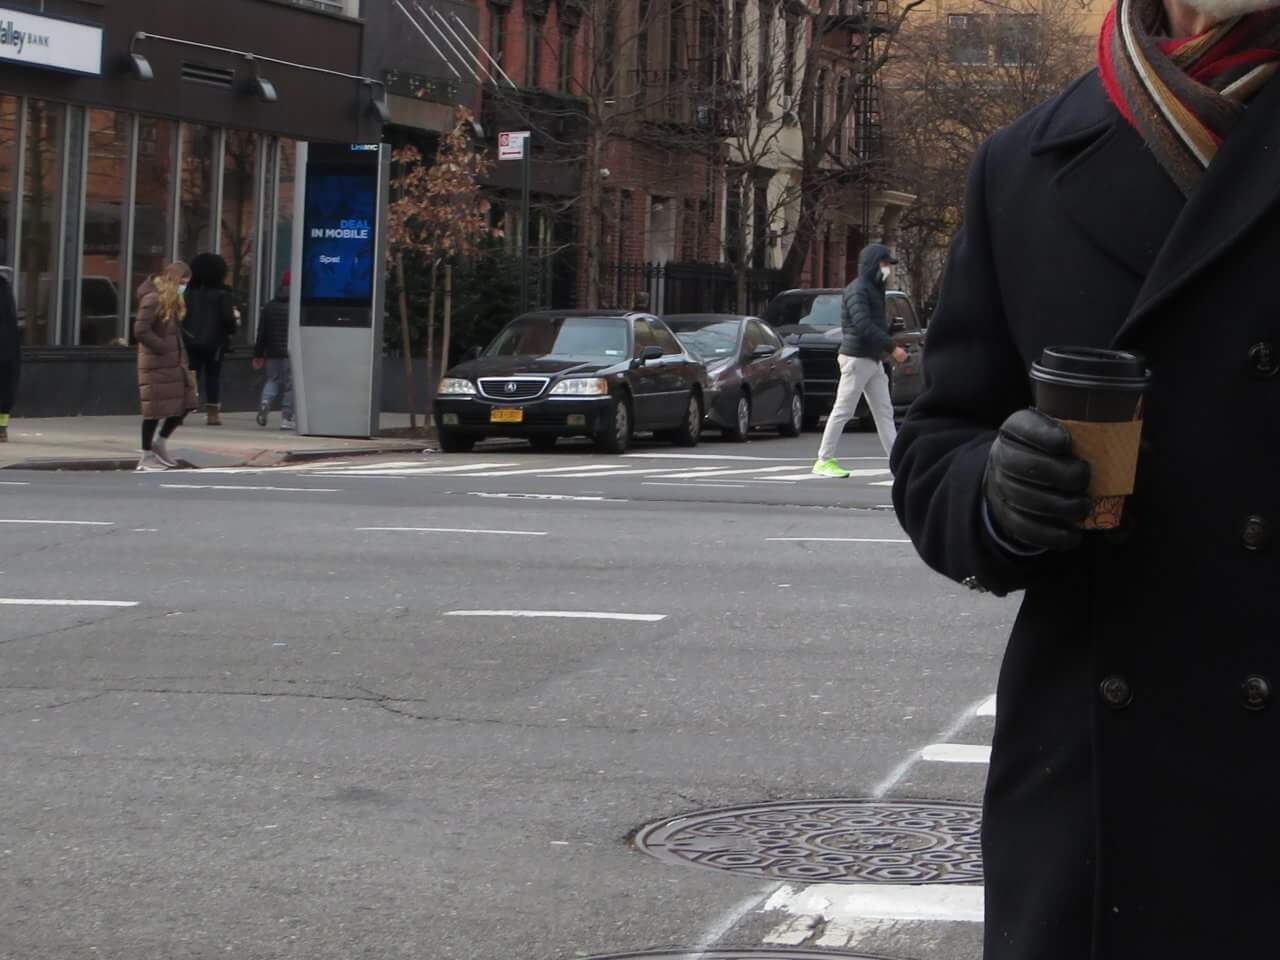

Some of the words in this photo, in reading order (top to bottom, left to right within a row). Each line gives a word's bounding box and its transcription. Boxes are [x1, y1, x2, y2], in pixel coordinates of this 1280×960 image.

[28, 33, 49, 48] BANK
[340, 219, 369, 229] DEAL
[311, 228, 324, 238] IN
[325, 228, 368, 239] MOBILE
